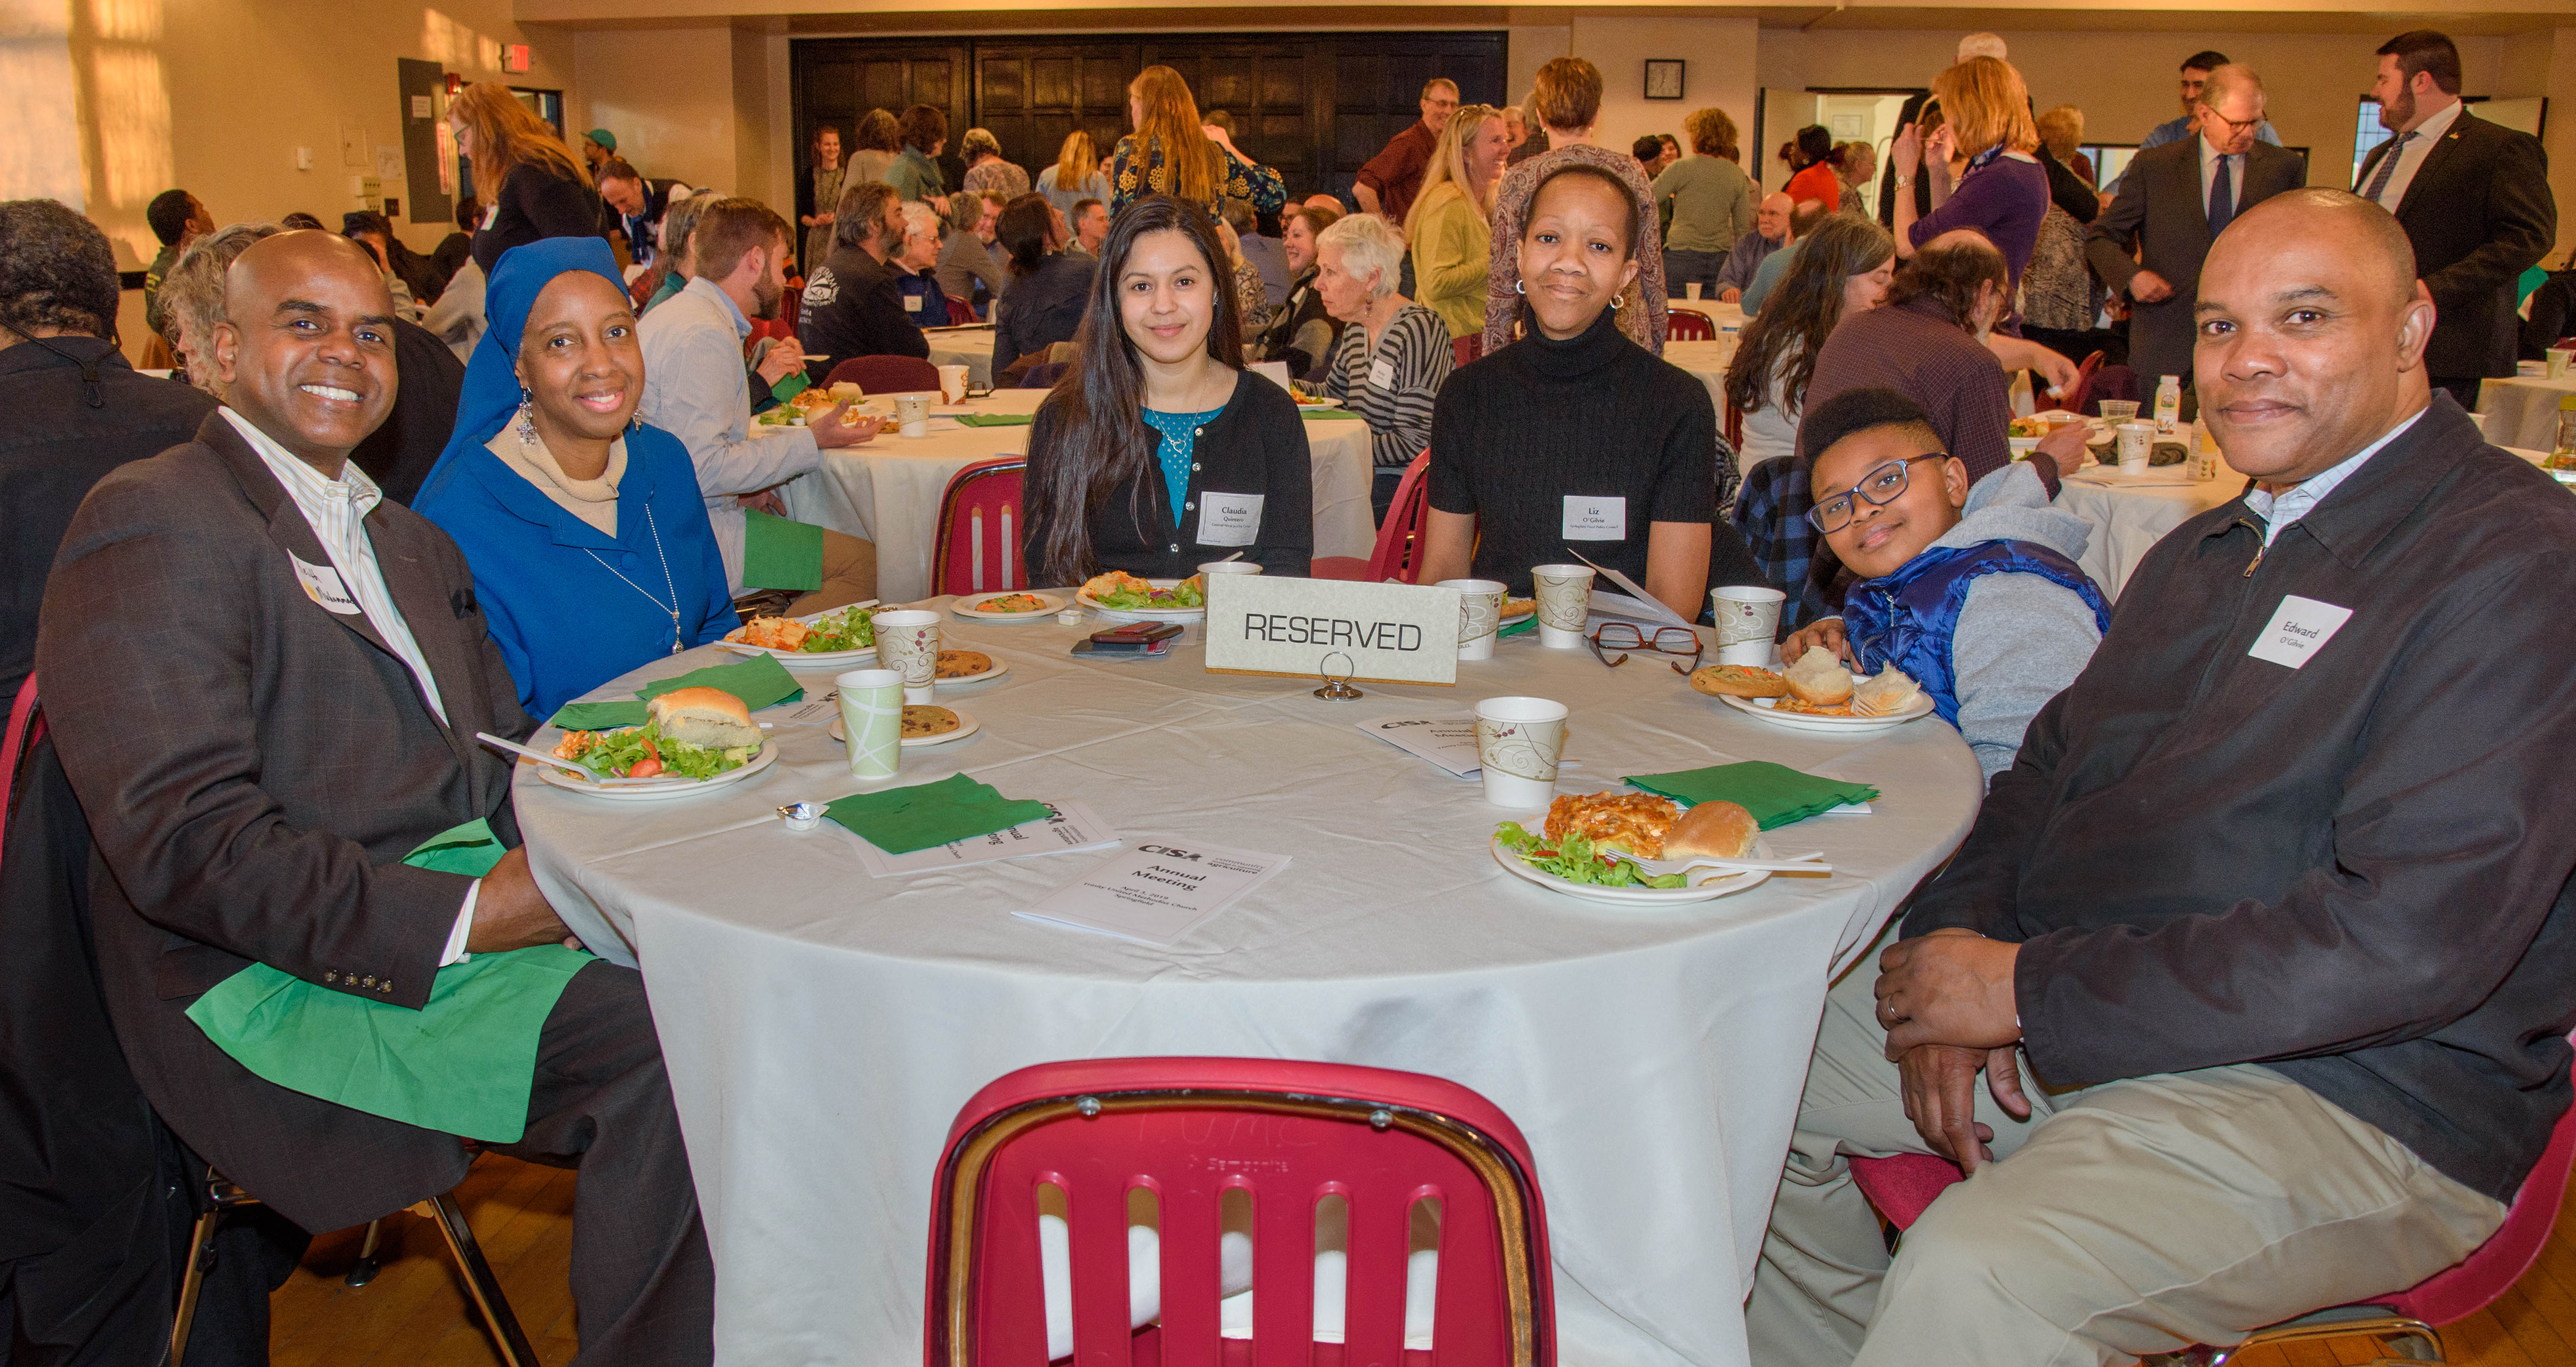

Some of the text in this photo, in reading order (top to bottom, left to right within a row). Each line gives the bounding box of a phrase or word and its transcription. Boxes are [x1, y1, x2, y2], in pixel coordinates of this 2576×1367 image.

[1245, 613, 1421, 652] RESERVED
[2283, 621, 2321, 639] Edward
[2280, 636, 2305, 649] O'Gilvie
[1381, 720, 1435, 729] CISA
[987, 832, 1004, 845] ting
[1007, 825, 1030, 840] nual
[1138, 845, 1203, 862] CISA
[1146, 865, 1207, 881] Annual
[1207, 862, 1258, 874] agriculture
[1132, 871, 1198, 891] Meeting
